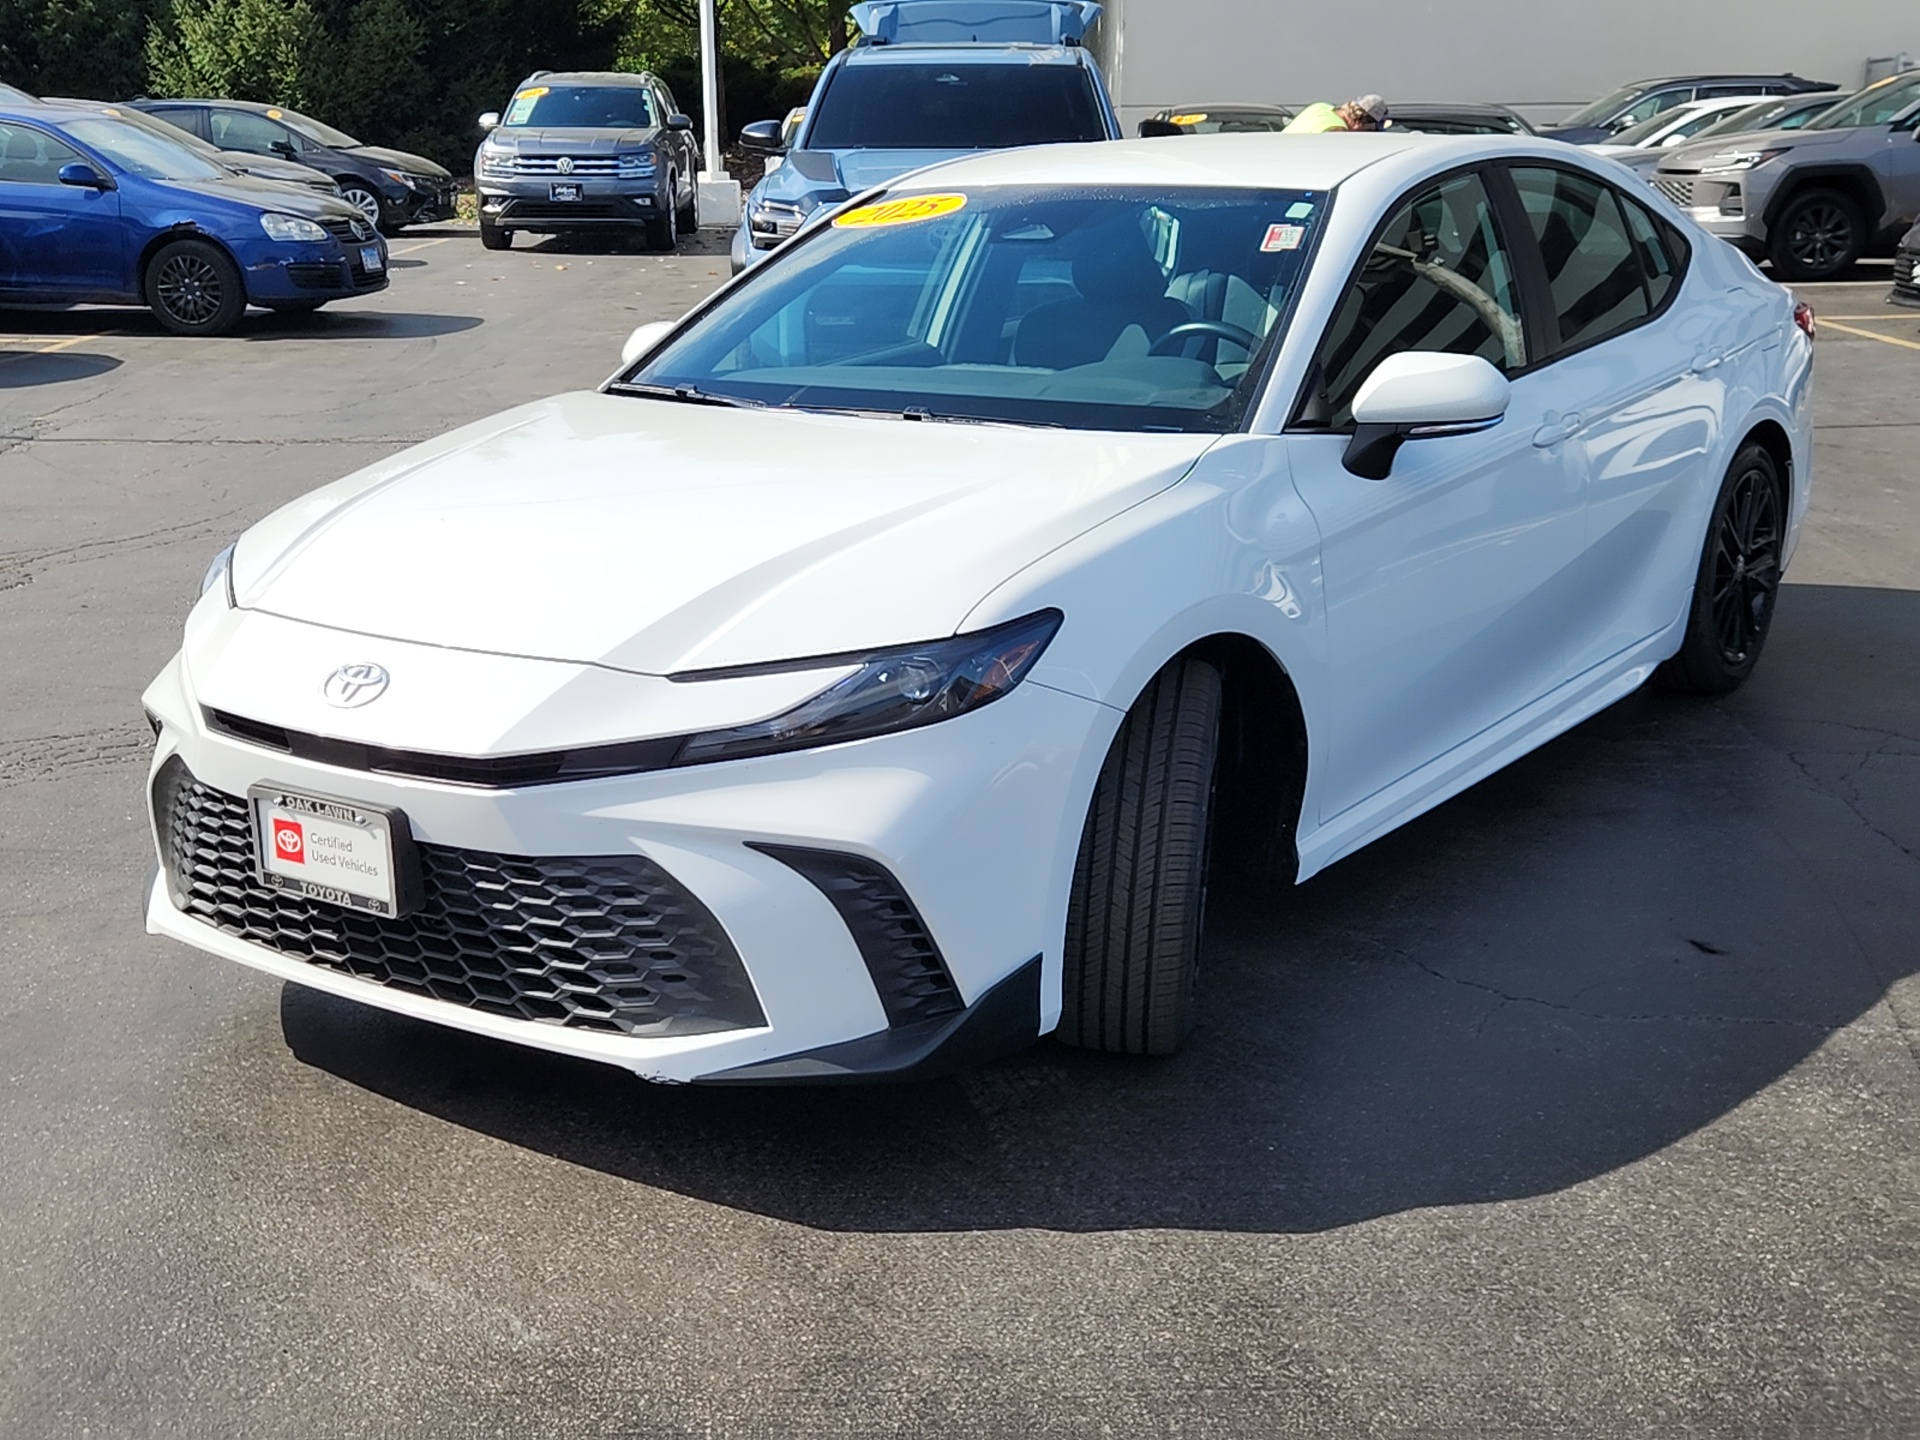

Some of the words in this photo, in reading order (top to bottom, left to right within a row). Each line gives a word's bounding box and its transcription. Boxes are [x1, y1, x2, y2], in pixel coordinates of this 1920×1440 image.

[286, 796, 314, 813] OAK
[316, 803, 353, 821] LAWN
[310, 832, 353, 852] Certified
[312, 850, 336, 865] Used
[338, 855, 378, 876] Vehicles
[300, 882, 352, 905] TOYOTA
